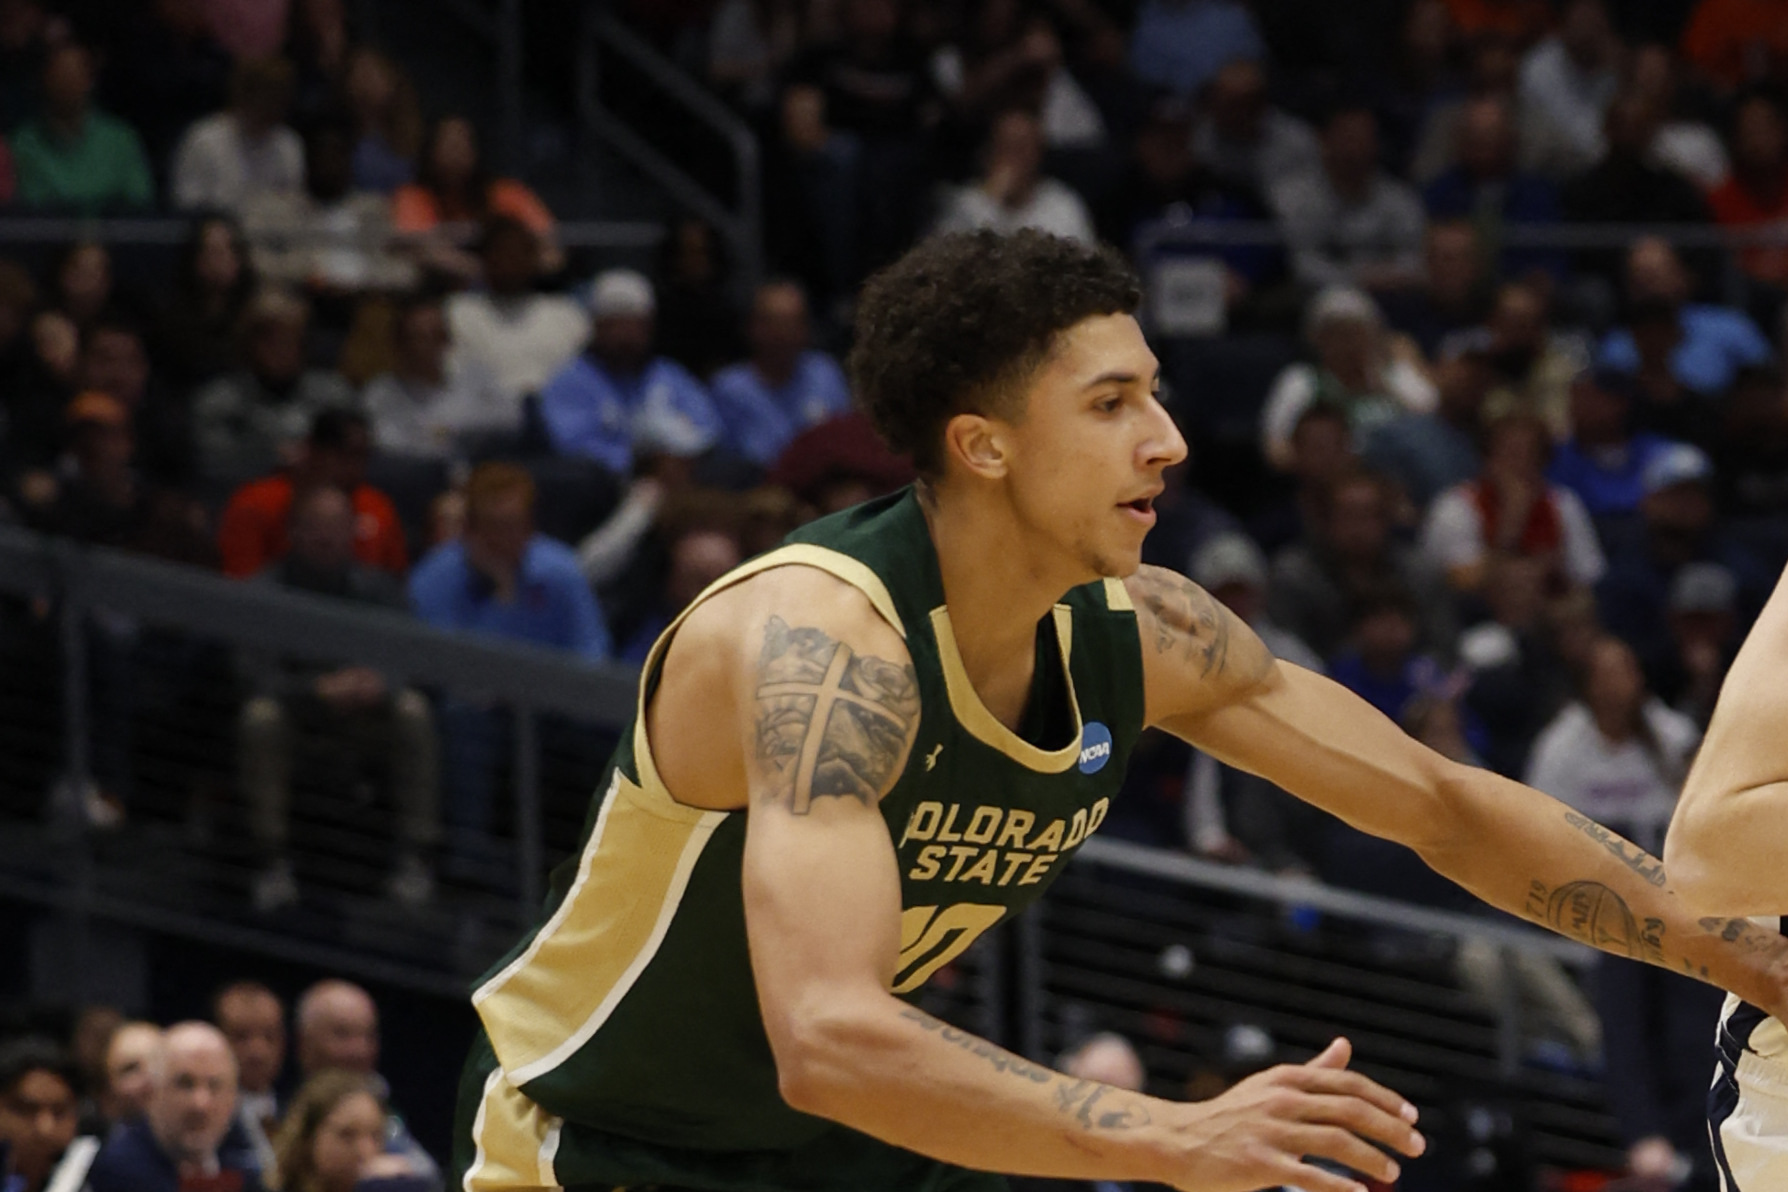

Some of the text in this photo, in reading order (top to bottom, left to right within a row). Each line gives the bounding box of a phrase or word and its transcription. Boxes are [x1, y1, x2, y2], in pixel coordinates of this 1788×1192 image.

[1079, 741, 1111, 765] NCAA
[899, 796, 1110, 852] OLORADO
[908, 845, 1059, 887] STATE
